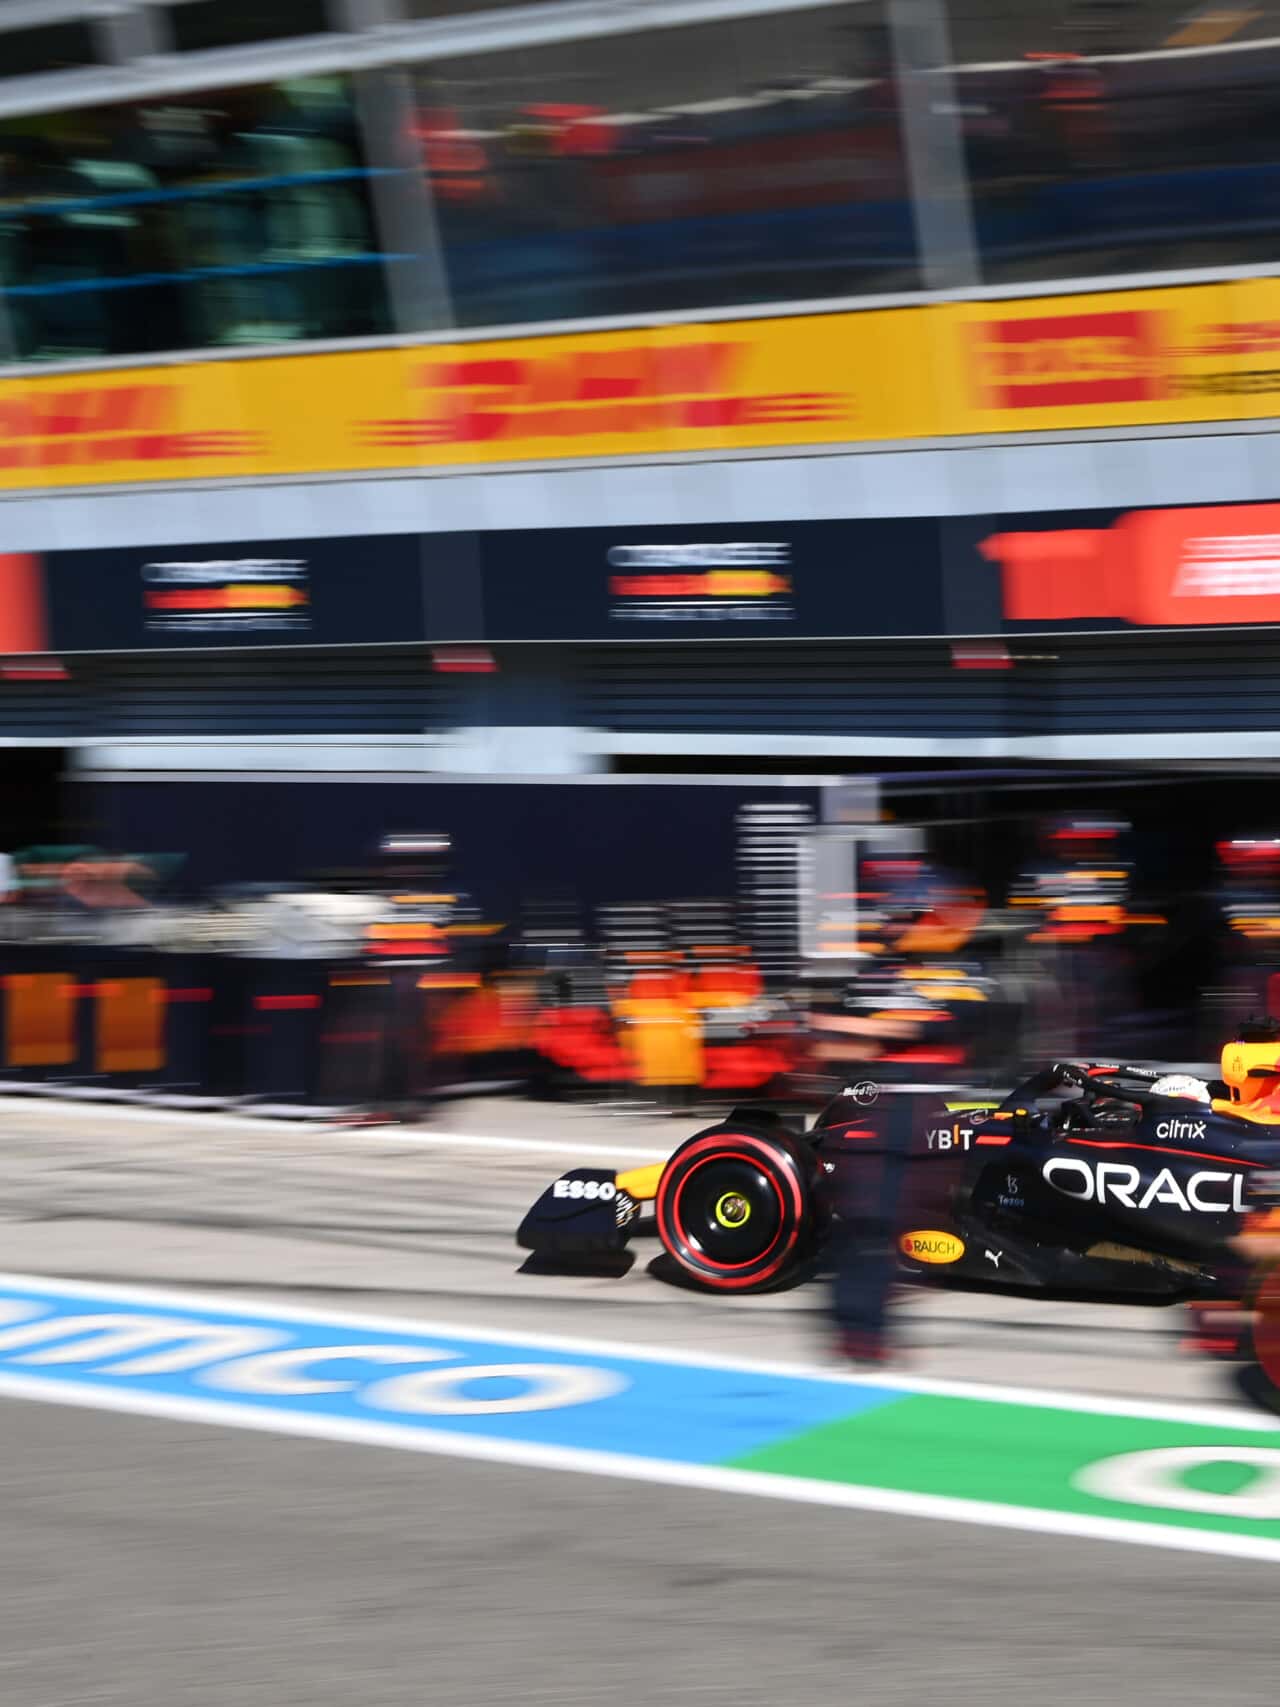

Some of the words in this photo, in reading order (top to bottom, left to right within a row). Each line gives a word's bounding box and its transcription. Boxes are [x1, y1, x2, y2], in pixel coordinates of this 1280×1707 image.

[926, 1124, 973, 1150] YBIT
[1156, 1120, 1207, 1139] citrix
[553, 1180, 616, 1200] ESSO
[914, 1240, 955, 1255] RAUCH
[0, 1299, 630, 1415] mco
